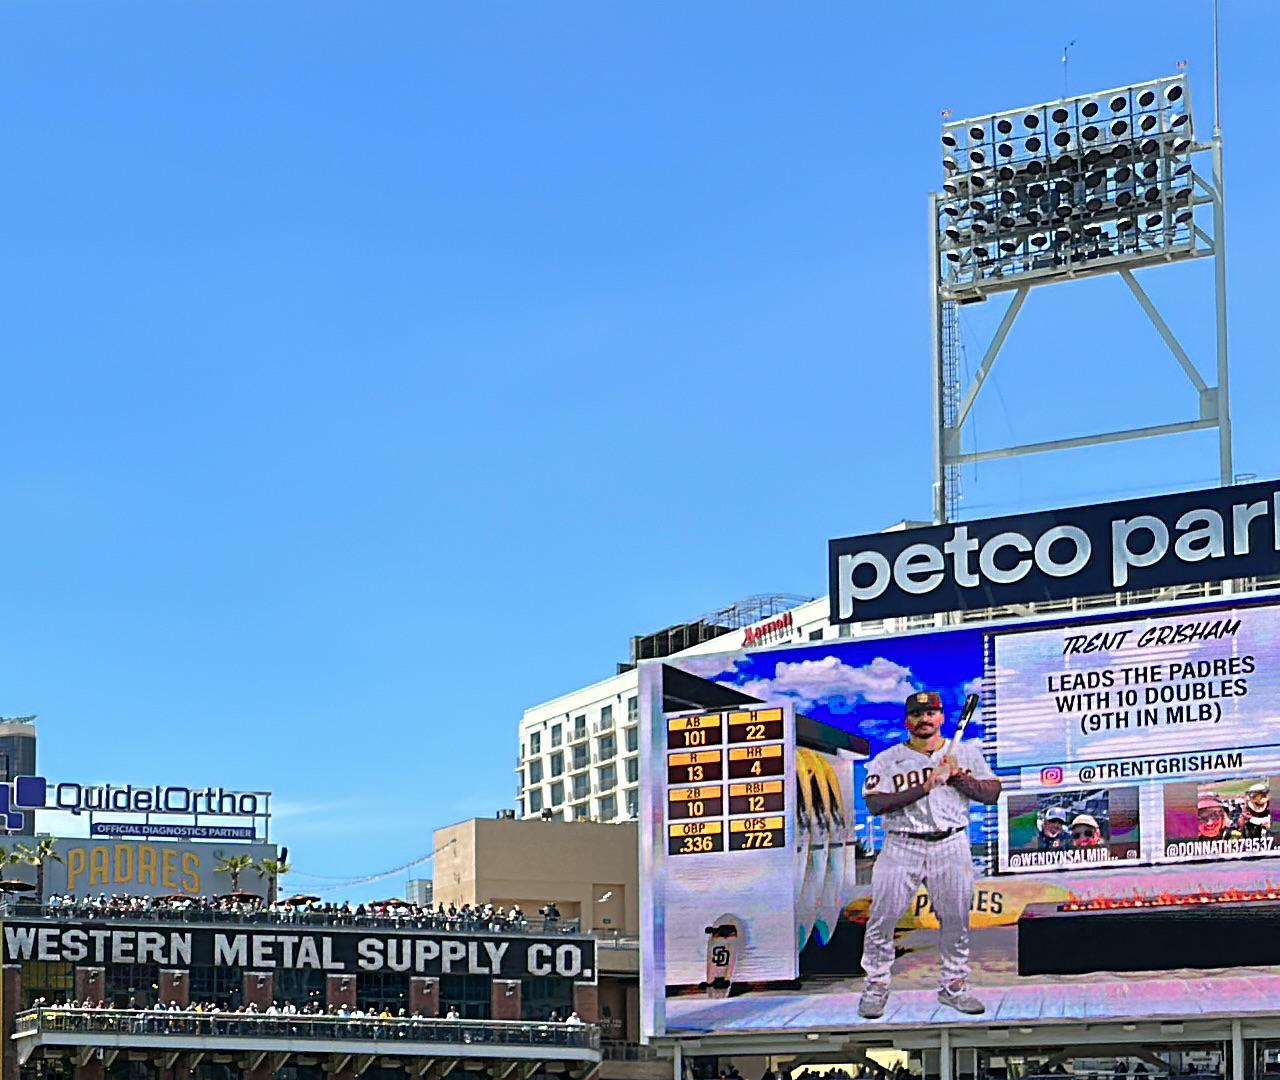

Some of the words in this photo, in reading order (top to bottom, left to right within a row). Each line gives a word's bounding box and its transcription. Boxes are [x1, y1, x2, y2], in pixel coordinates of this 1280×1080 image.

[838, 525, 1092, 620] petco
[1111, 491, 1280, 587] par
[1063, 630, 1133, 655] TRENT
[1137, 619, 1241, 648] GRISHAM
[1048, 669, 1114, 693] LEADS
[1121, 665, 1162, 685] THE
[1169, 656, 1255, 680] PADRES
[1056, 692, 1109, 713] WITH
[1116, 689, 1138, 707] 10
[1145, 678, 1248, 705] DOUBLES
[686, 717, 700, 728] AB
[1081, 711, 1129, 735] (9TH
[1136, 707, 1158, 727] IN
[1166, 702, 1222, 724] MLB)
[684, 730, 706, 746] 101
[746, 724, 766, 740] 22
[687, 765, 704, 781] 13
[750, 760, 761, 775] 4
[1079, 753, 1243, 783] @TRENTGRISHAM
[56, 783, 258, 815] QuidelOrtho
[687, 788, 700, 798] 2B
[745, 783, 764, 793] RBI
[687, 801, 704, 817] 10
[748, 796, 765, 812] 12
[97, 823, 141, 834] OFFICIAL
[142, 825, 207, 836] DIAGNOSTICS
[208, 827, 253, 838] PARTNER
[683, 823, 706, 834] OBP
[744, 818, 766, 830] OPS
[680, 836, 713, 853] .336
[742, 832, 773, 849] .772
[67, 844, 201, 894] PADRES
[4, 926, 192, 964] WESTERN
[214, 932, 345, 969] METAL
[357, 938, 510, 975] SUPPLY
[527, 943, 593, 978] CO.
